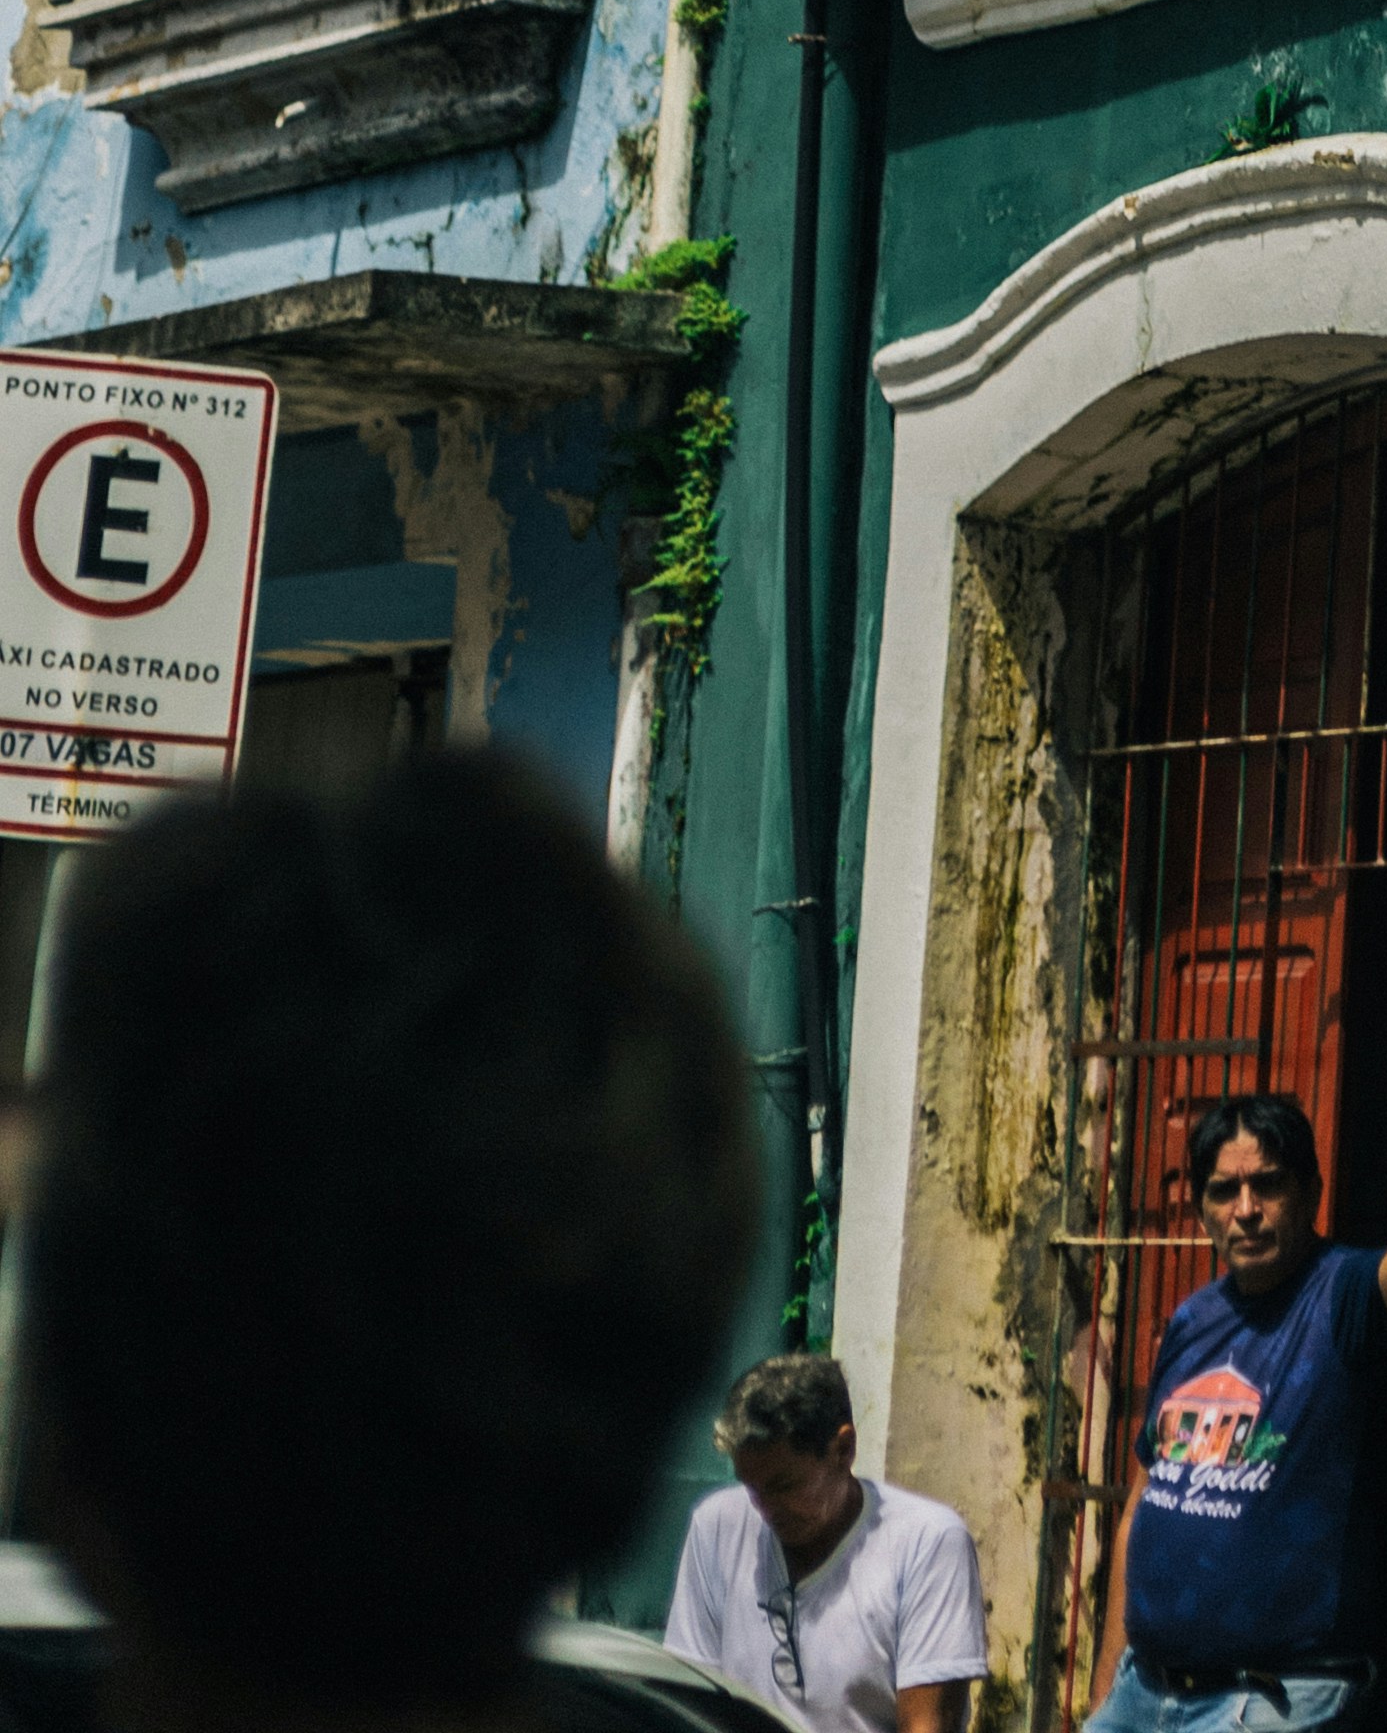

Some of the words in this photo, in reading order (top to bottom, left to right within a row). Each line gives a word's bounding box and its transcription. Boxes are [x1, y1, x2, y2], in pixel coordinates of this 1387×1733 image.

[5, 376, 96, 403] PONTO
[105, 385, 164, 409] FIXO
[206, 396, 248, 418] 312
[75, 454, 160, 585] E
[41, 649, 220, 684] CADASTRADO
[26, 686, 62, 708] NO
[72, 691, 159, 717] VERSO
[0, 731, 34, 758] 07
[46, 735, 156, 769] VAGAS
[28, 791, 131, 821] TÉRMINO
